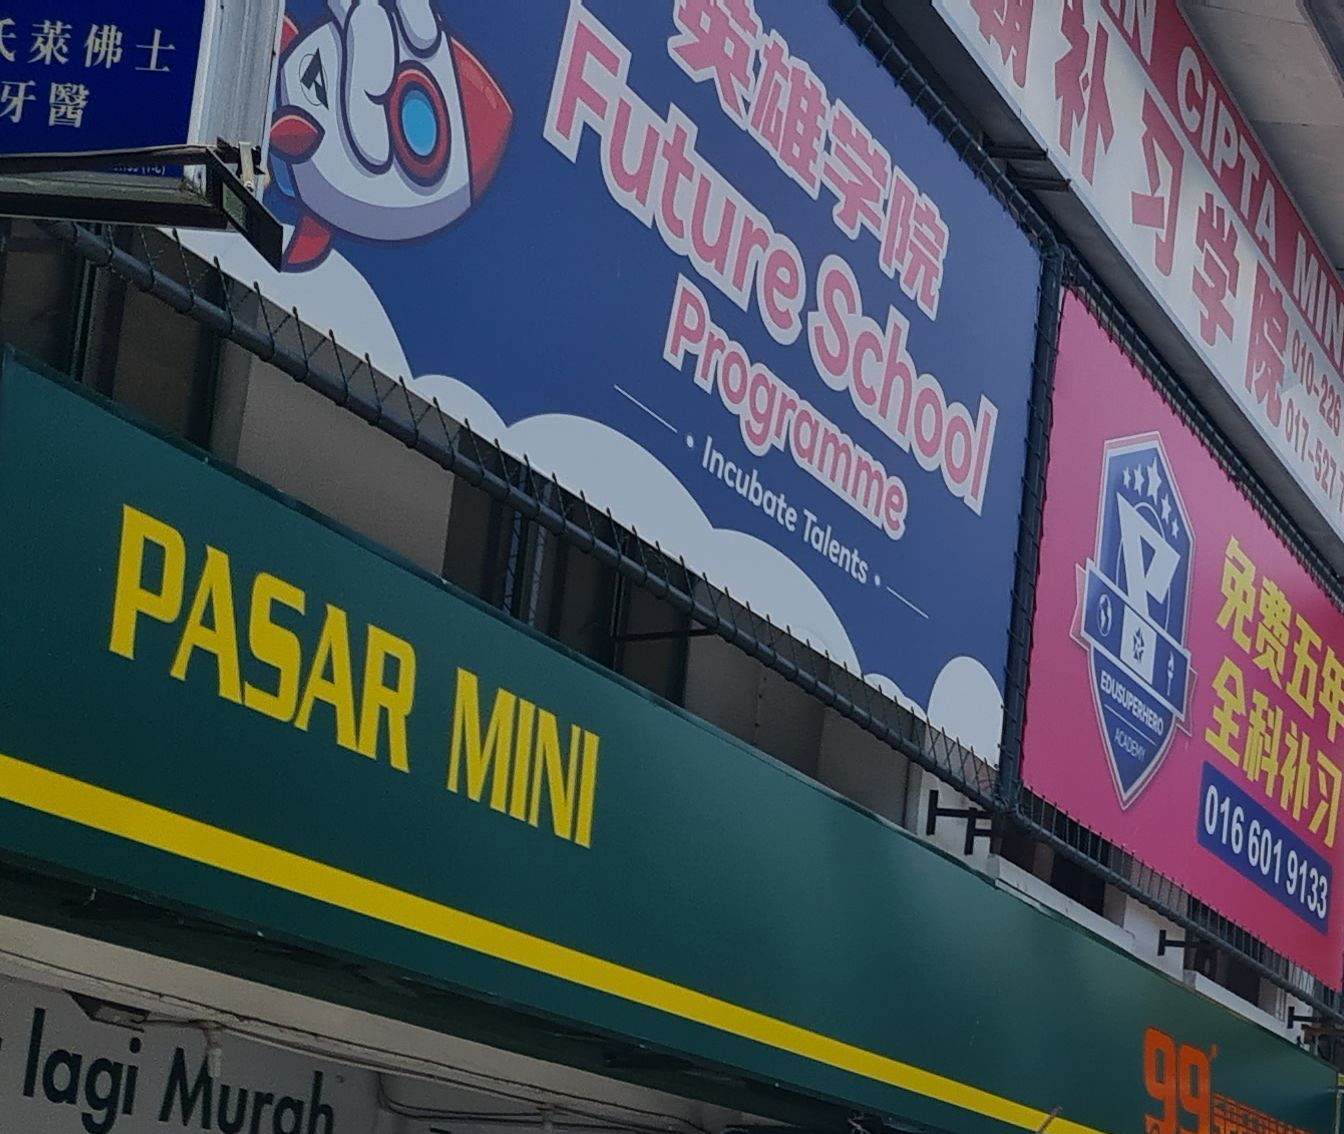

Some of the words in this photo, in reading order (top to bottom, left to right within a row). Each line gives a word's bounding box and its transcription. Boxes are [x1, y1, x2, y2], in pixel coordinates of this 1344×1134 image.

[0, 80, 90, 128] 牙醫
[669, 0, 947, 315] 英雄学院
[1177, 46, 1276, 263] CIPTA
[550, 12, 803, 335] Future
[810, 262, 995, 508] School
[667, 280, 907, 535] Programme
[1285, 398, 1336, 499] 017-527
[1292, 329, 1341, 436] 010-226
[702, 436, 797, 532] Incubate
[802, 509, 869, 584] Talents
[109, 503, 416, 773] PASAR
[447, 667, 600, 849] MINI
[1101, 670, 1165, 737] EDUSUPERHERO
[1205, 655, 1343, 848] 全科补习
[1205, 784, 1244, 854] 016
[1248, 819, 1282, 884] 601
[1287, 849, 1328, 919] 9133
